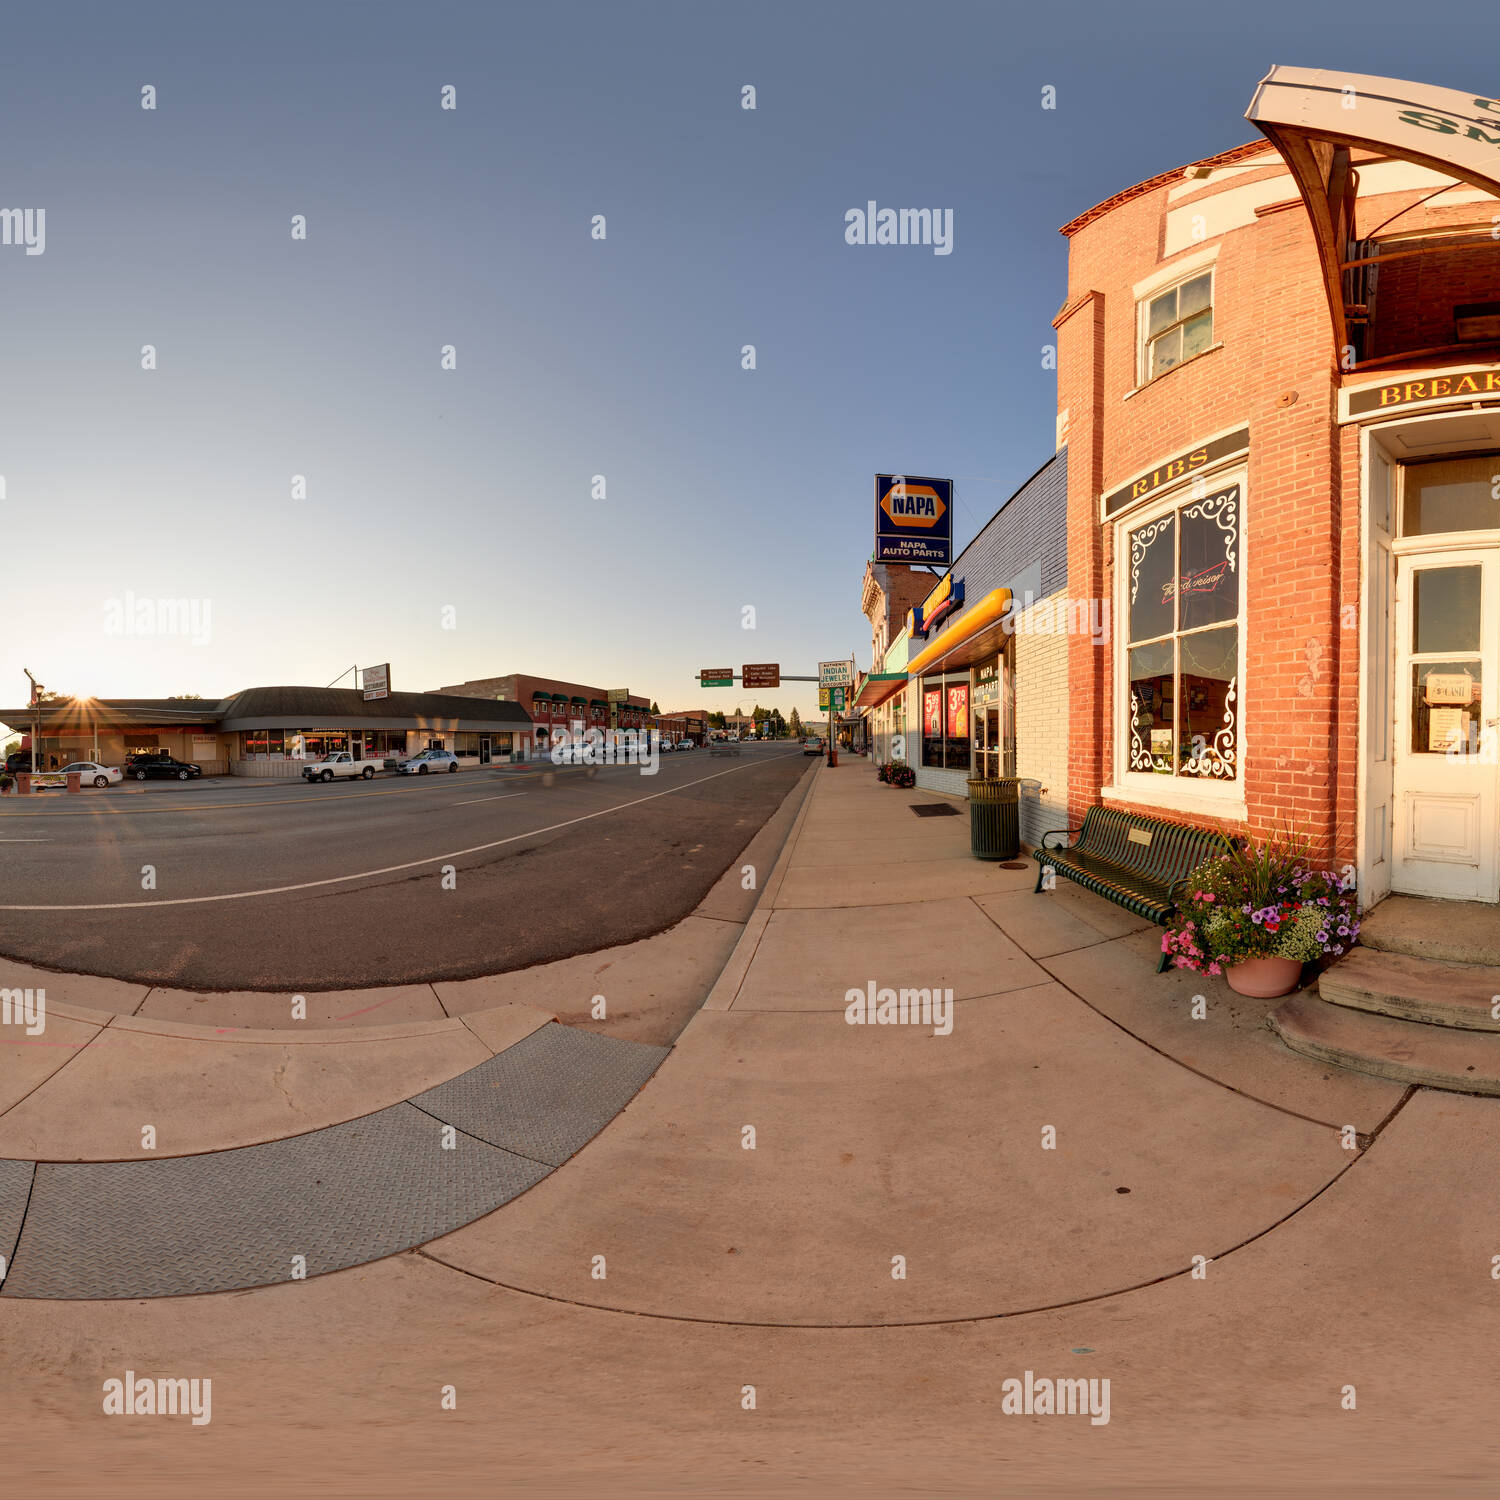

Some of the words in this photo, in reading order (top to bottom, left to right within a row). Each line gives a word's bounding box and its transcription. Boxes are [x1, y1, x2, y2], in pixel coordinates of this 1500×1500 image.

[1131, 448, 1208, 500] RIBS
[893, 496, 935, 516] NAPA
[900, 541, 927, 549] NAPA
[883, 547, 910, 555] AUTO
[912, 549, 945, 558] PARTS
[821, 674, 849, 682] JEWELRY
[981, 666, 993, 680] NAPA
